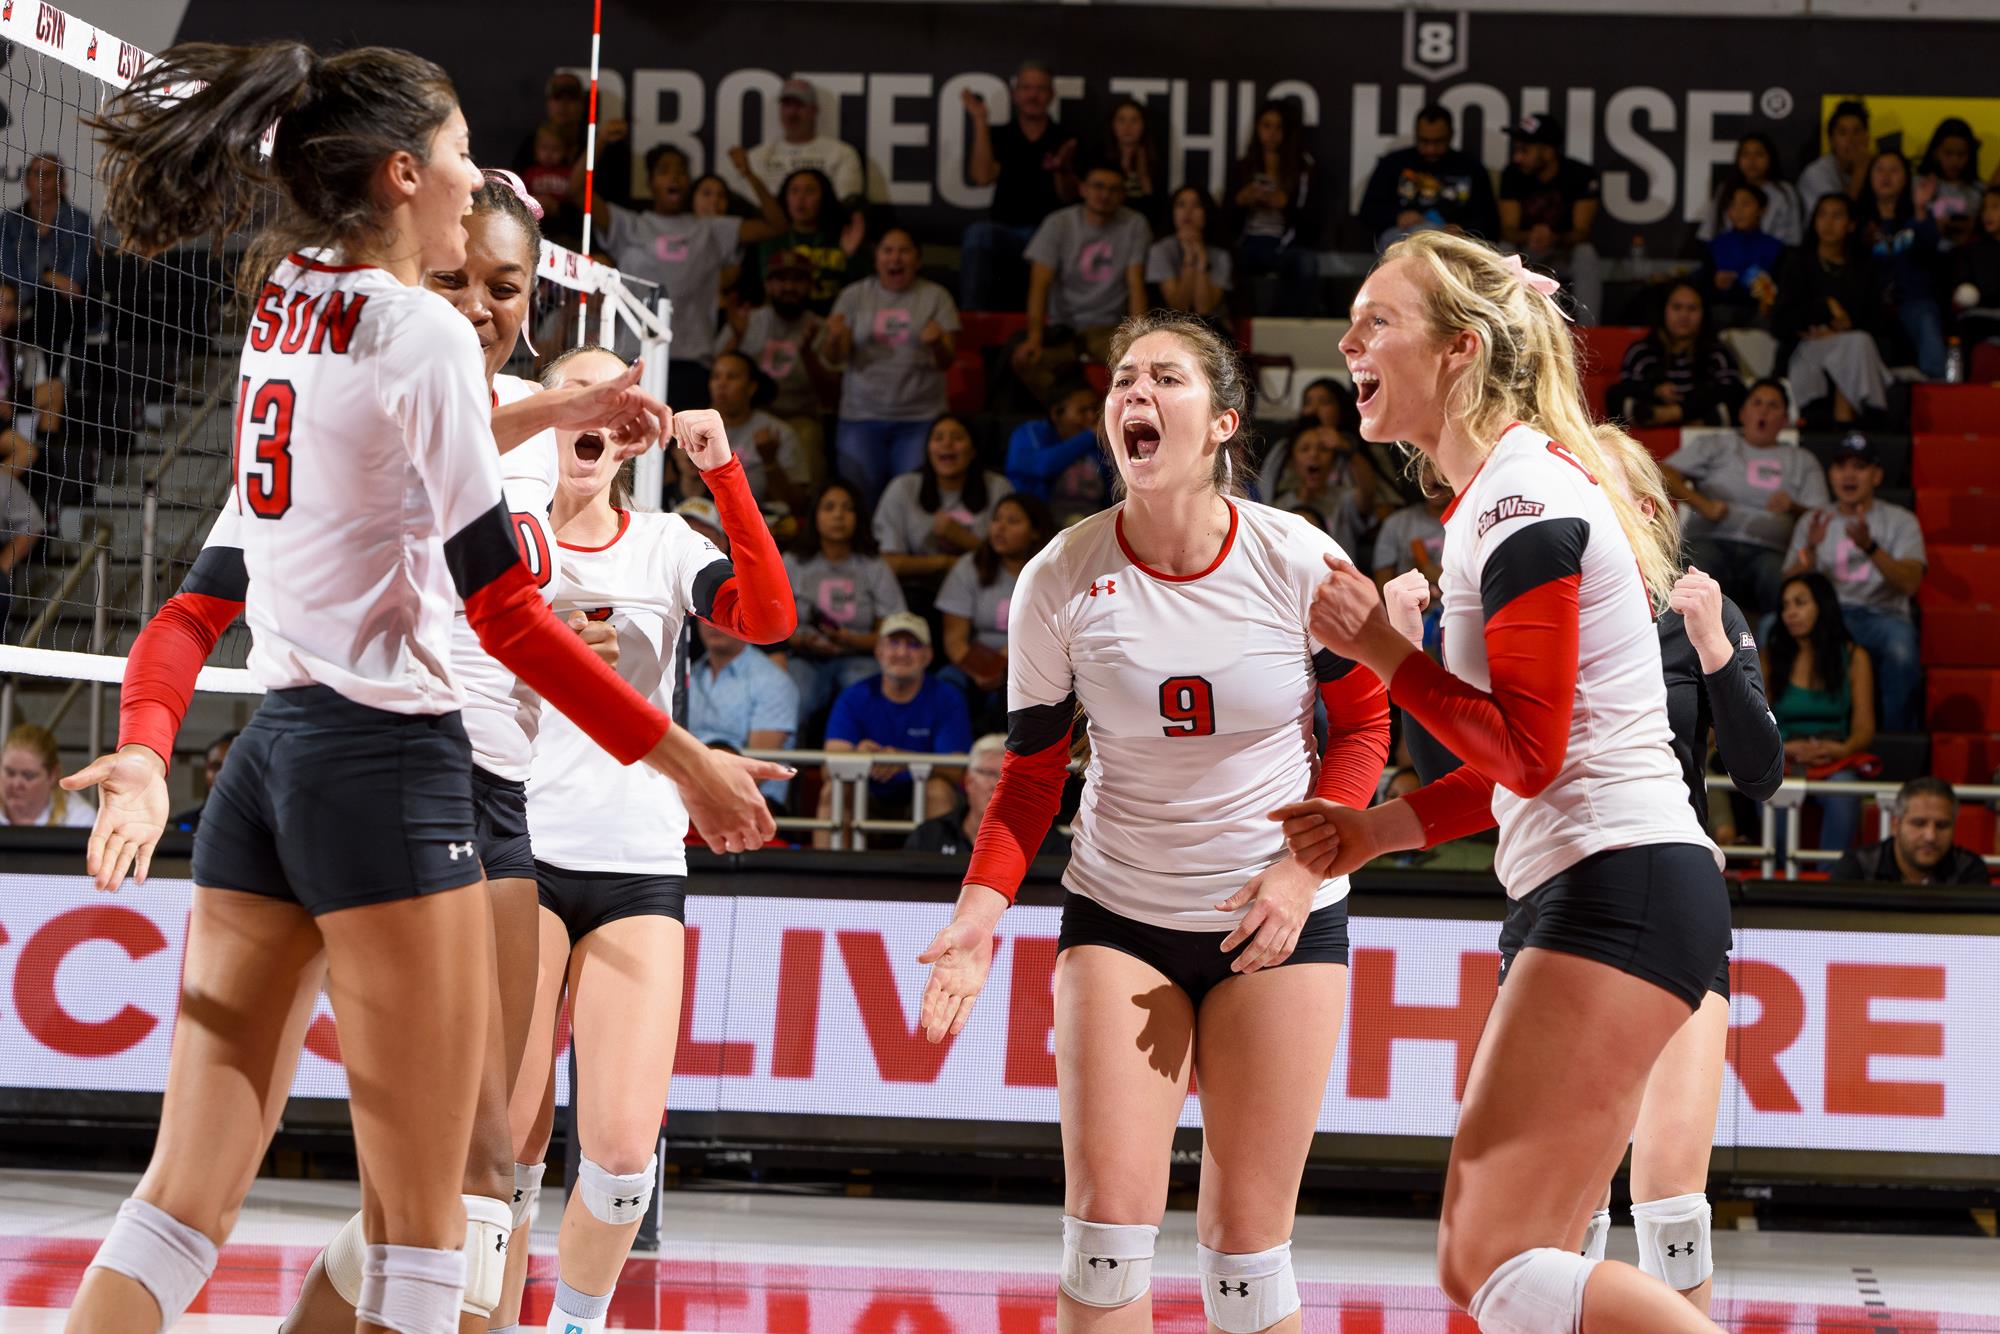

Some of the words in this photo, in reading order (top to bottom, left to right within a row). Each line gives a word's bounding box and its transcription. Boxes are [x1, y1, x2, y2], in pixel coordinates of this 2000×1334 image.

[1497, 495, 1545, 519] WEST
[1159, 676, 1215, 737] 9
[668, 925, 1200, 1096] LIVE
[1346, 947, 1946, 1118] HRE
